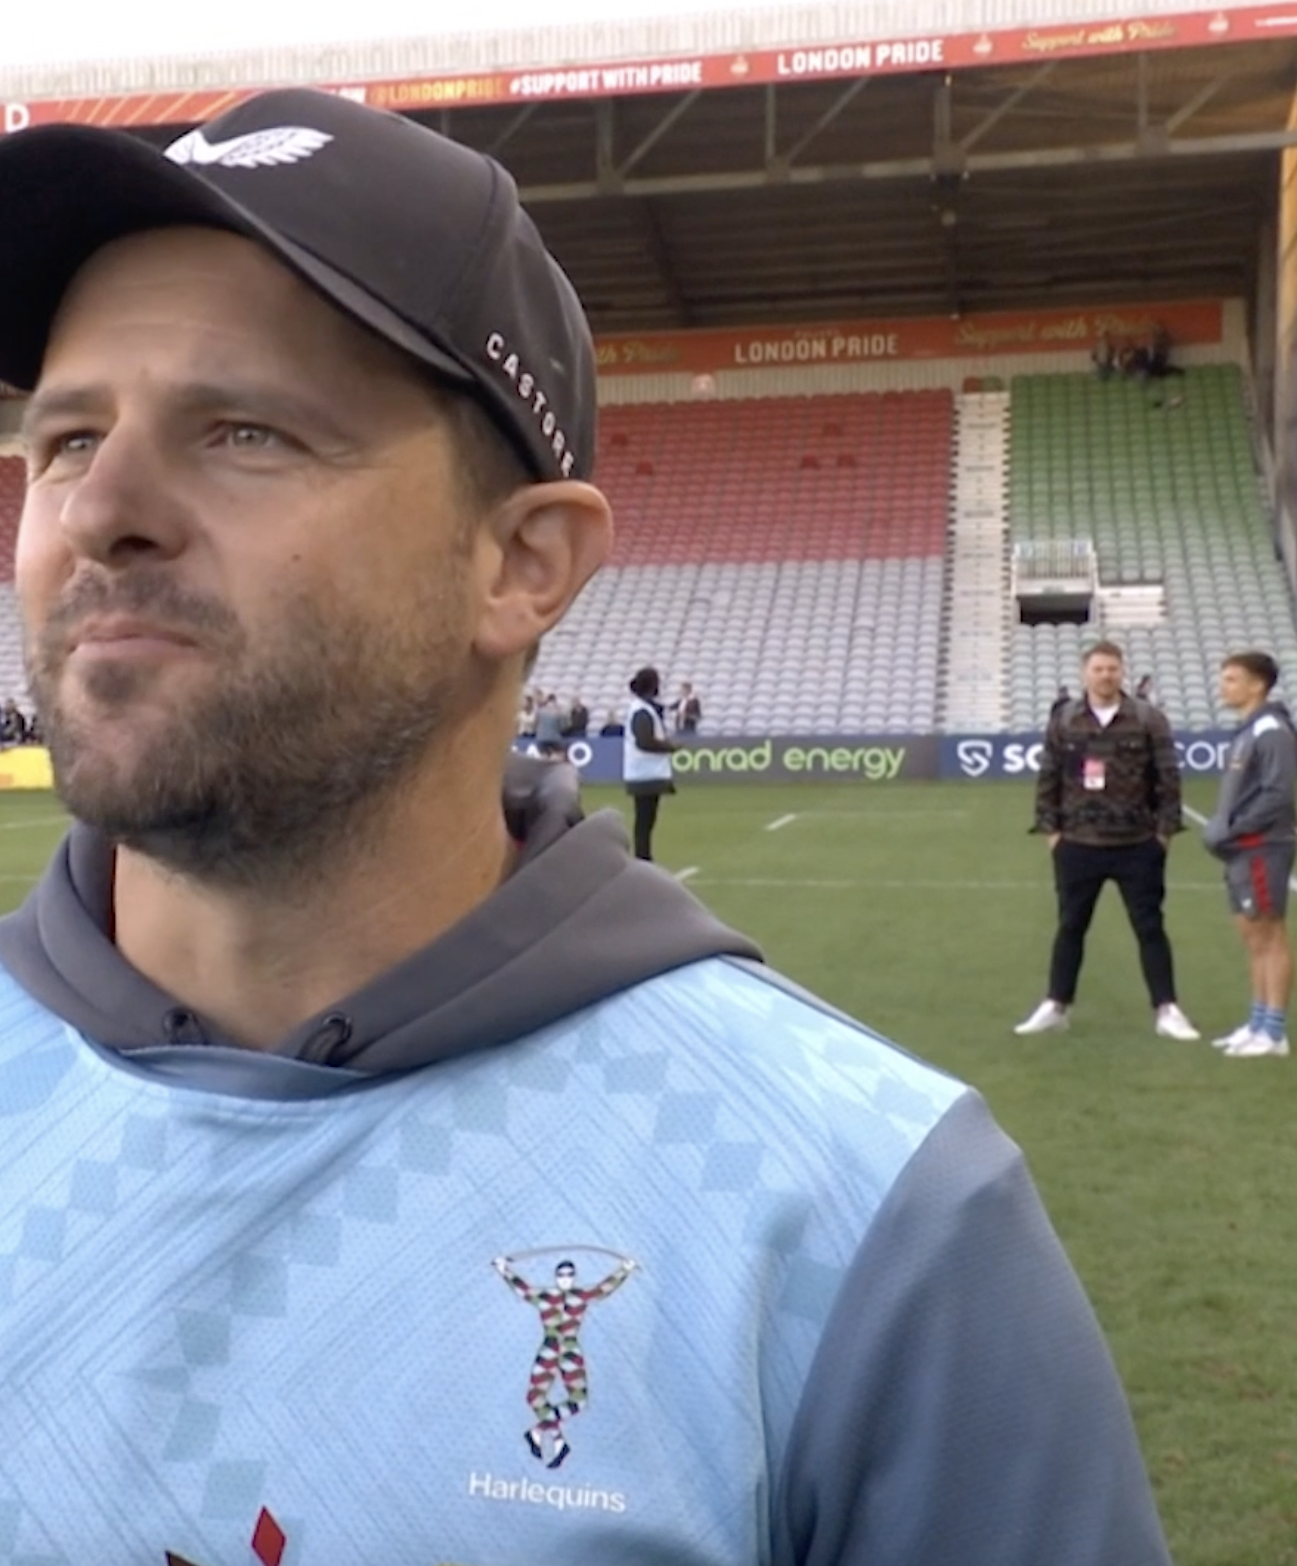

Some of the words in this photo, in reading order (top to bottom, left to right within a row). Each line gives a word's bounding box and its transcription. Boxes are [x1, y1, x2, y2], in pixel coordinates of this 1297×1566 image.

[1087, 23, 1123, 44] with
[778, 44, 871, 75] LONDON
[876, 40, 944, 67] PRIDE
[510, 69, 599, 95] #SUPPORT
[602, 66, 647, 88] WITH
[650, 61, 702, 85] PRIDE
[1039, 316, 1088, 340] with
[735, 338, 826, 363] LONDON
[831, 333, 899, 357] PRIDE
[672, 739, 772, 772] onrad
[783, 747, 906, 780] energy
[468, 1471, 626, 1512] Harlequins
